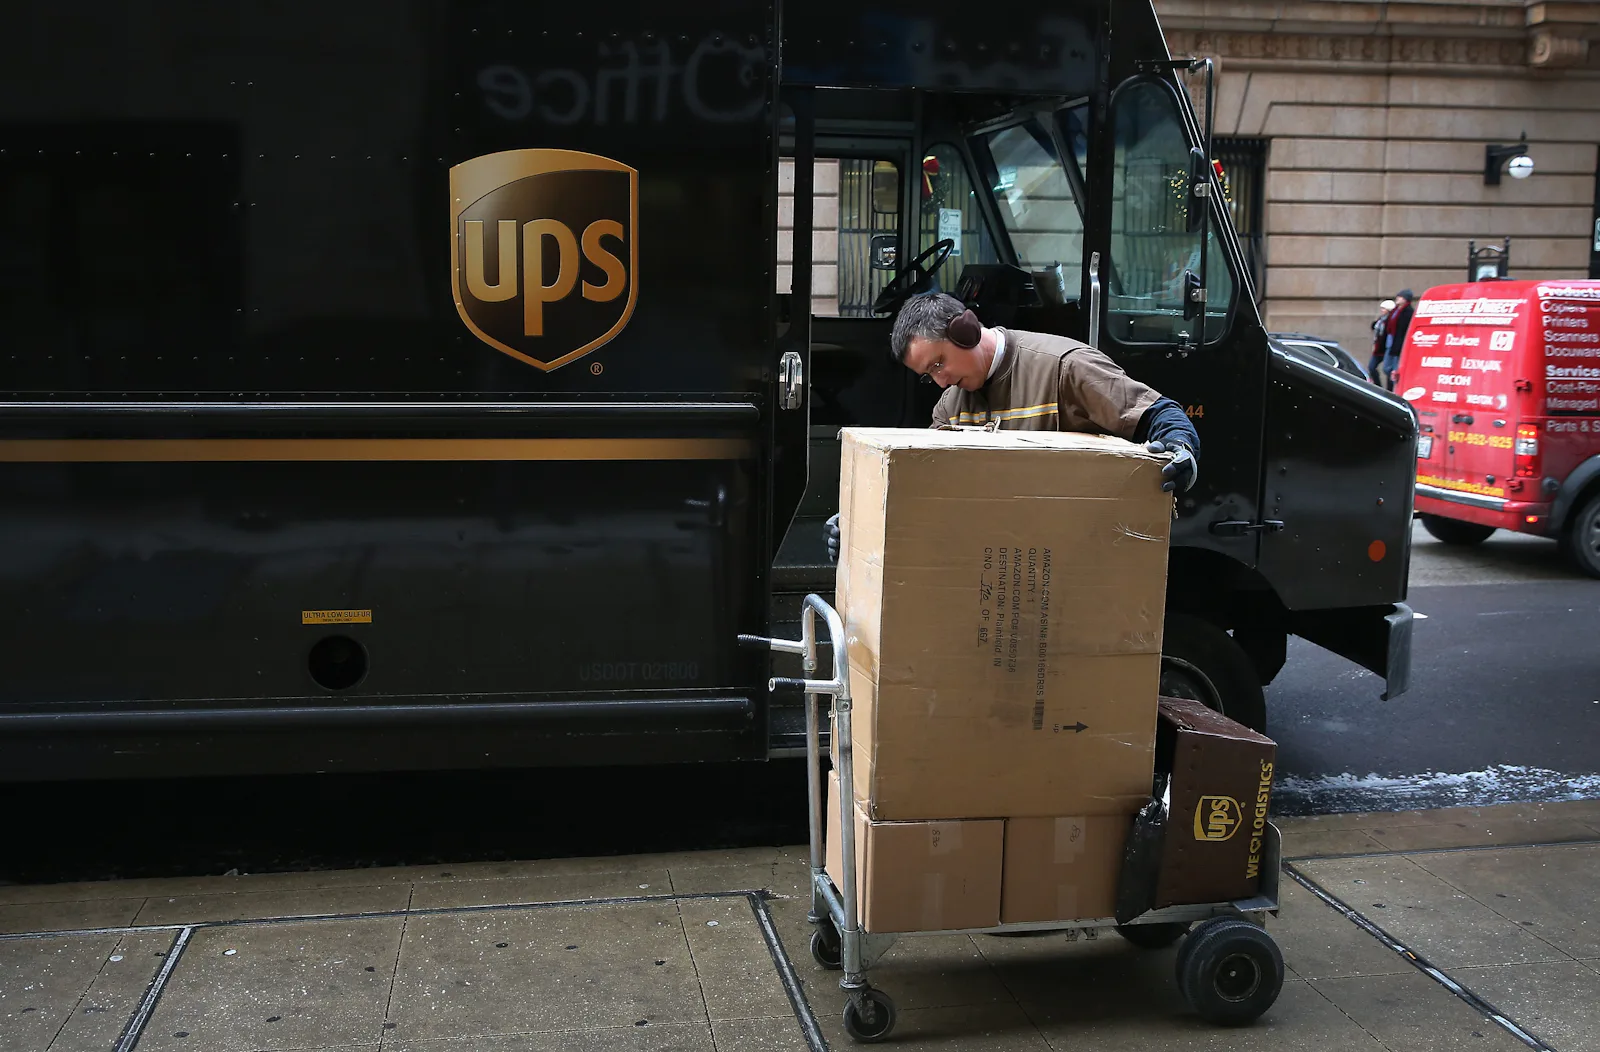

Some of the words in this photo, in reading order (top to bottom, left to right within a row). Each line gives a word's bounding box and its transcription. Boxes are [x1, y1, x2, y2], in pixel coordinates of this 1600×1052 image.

[464, 219, 626, 336] ups
[1540, 300, 1588, 314] Copiers
[1542, 316, 1589, 328] Printers
[1544, 330, 1599, 342] Scanners
[1546, 365, 1600, 377] Service
[1437, 374, 1471, 385] RICOH
[1184, 404, 1204, 418] 44
[1546, 397, 1597, 411] Managed
[1546, 420, 1577, 432] Parts
[1580, 420, 1589, 432] &
[996, 547, 1007, 610] DESTINATION:
[1011, 547, 1022, 610] AMAZON.COM
[1026, 547, 1037, 597] QUANTITY:
[1040, 547, 1051, 610] AMAZON.COM
[303, 611, 326, 619] ULTRA
[981, 609, 990, 621] OF
[979, 627, 989, 643] 667
[994, 657, 1002, 667] IN
[579, 662, 637, 681] USDOT
[641, 661, 699, 680] 021800
[1207, 799, 1235, 838] ups
[1246, 855, 1260, 879] WE
